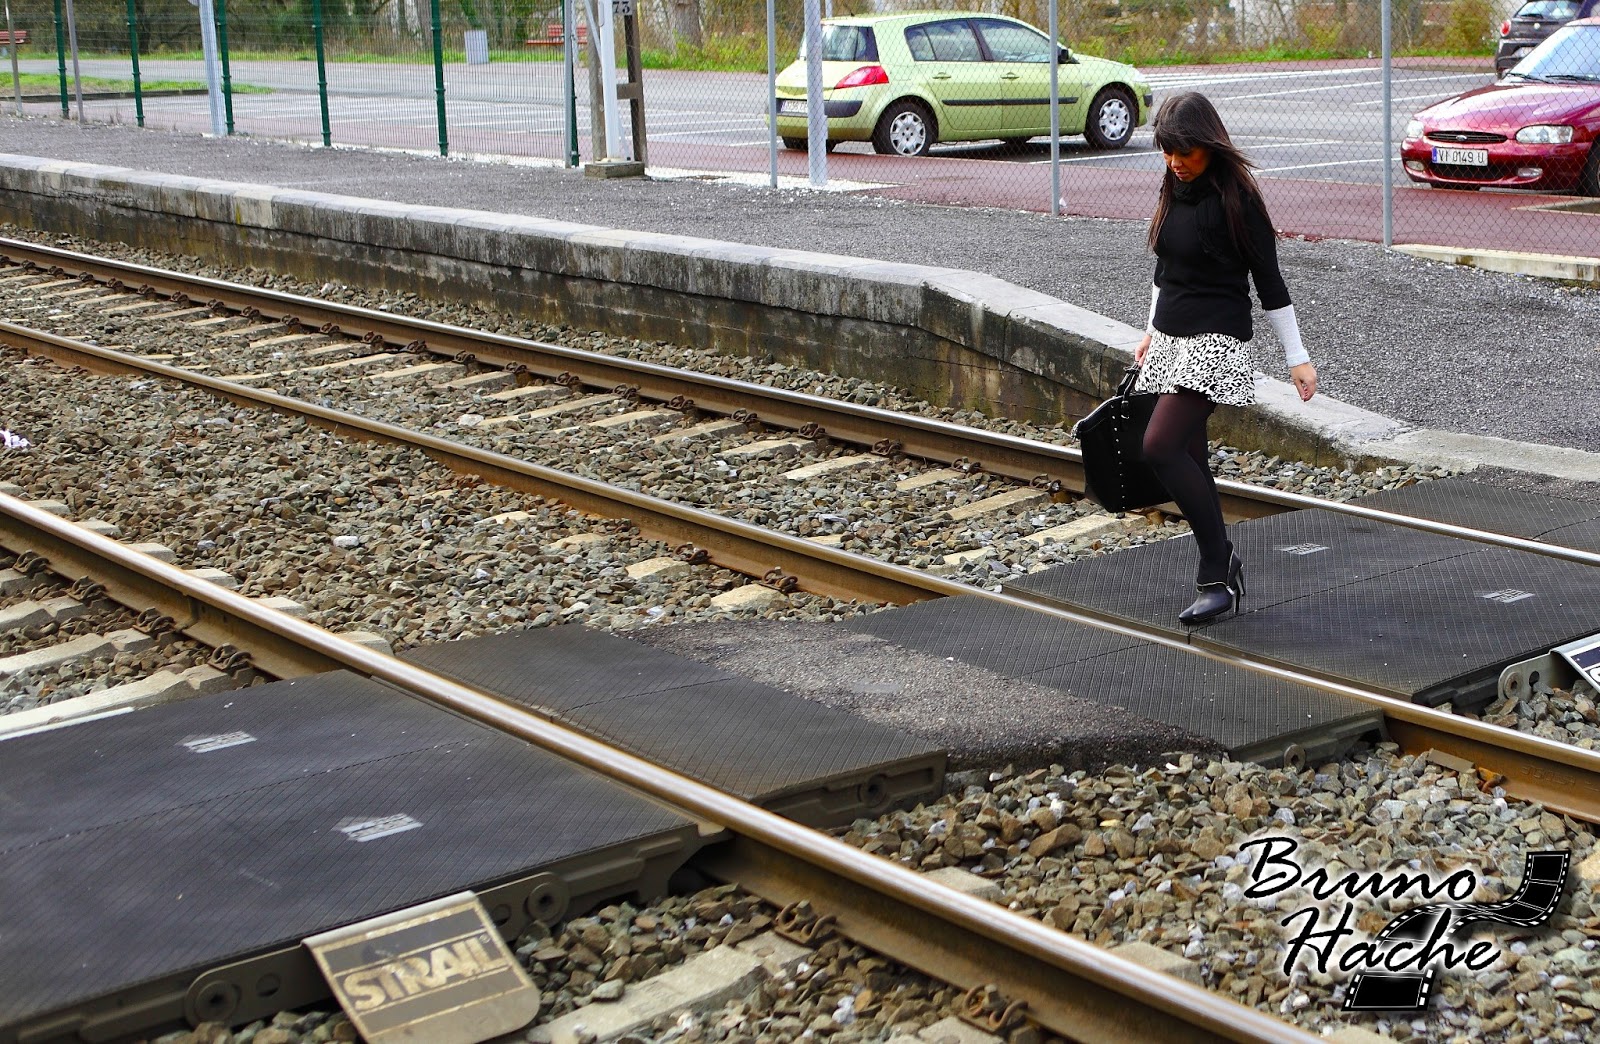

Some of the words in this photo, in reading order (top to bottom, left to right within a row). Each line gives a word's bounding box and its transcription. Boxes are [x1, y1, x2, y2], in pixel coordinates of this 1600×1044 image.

[1438, 149, 1448, 162] VI
[1452, 151, 1474, 163] 0149
[1478, 152, 1484, 163] U
[343, 936, 507, 1011] STRAIL
